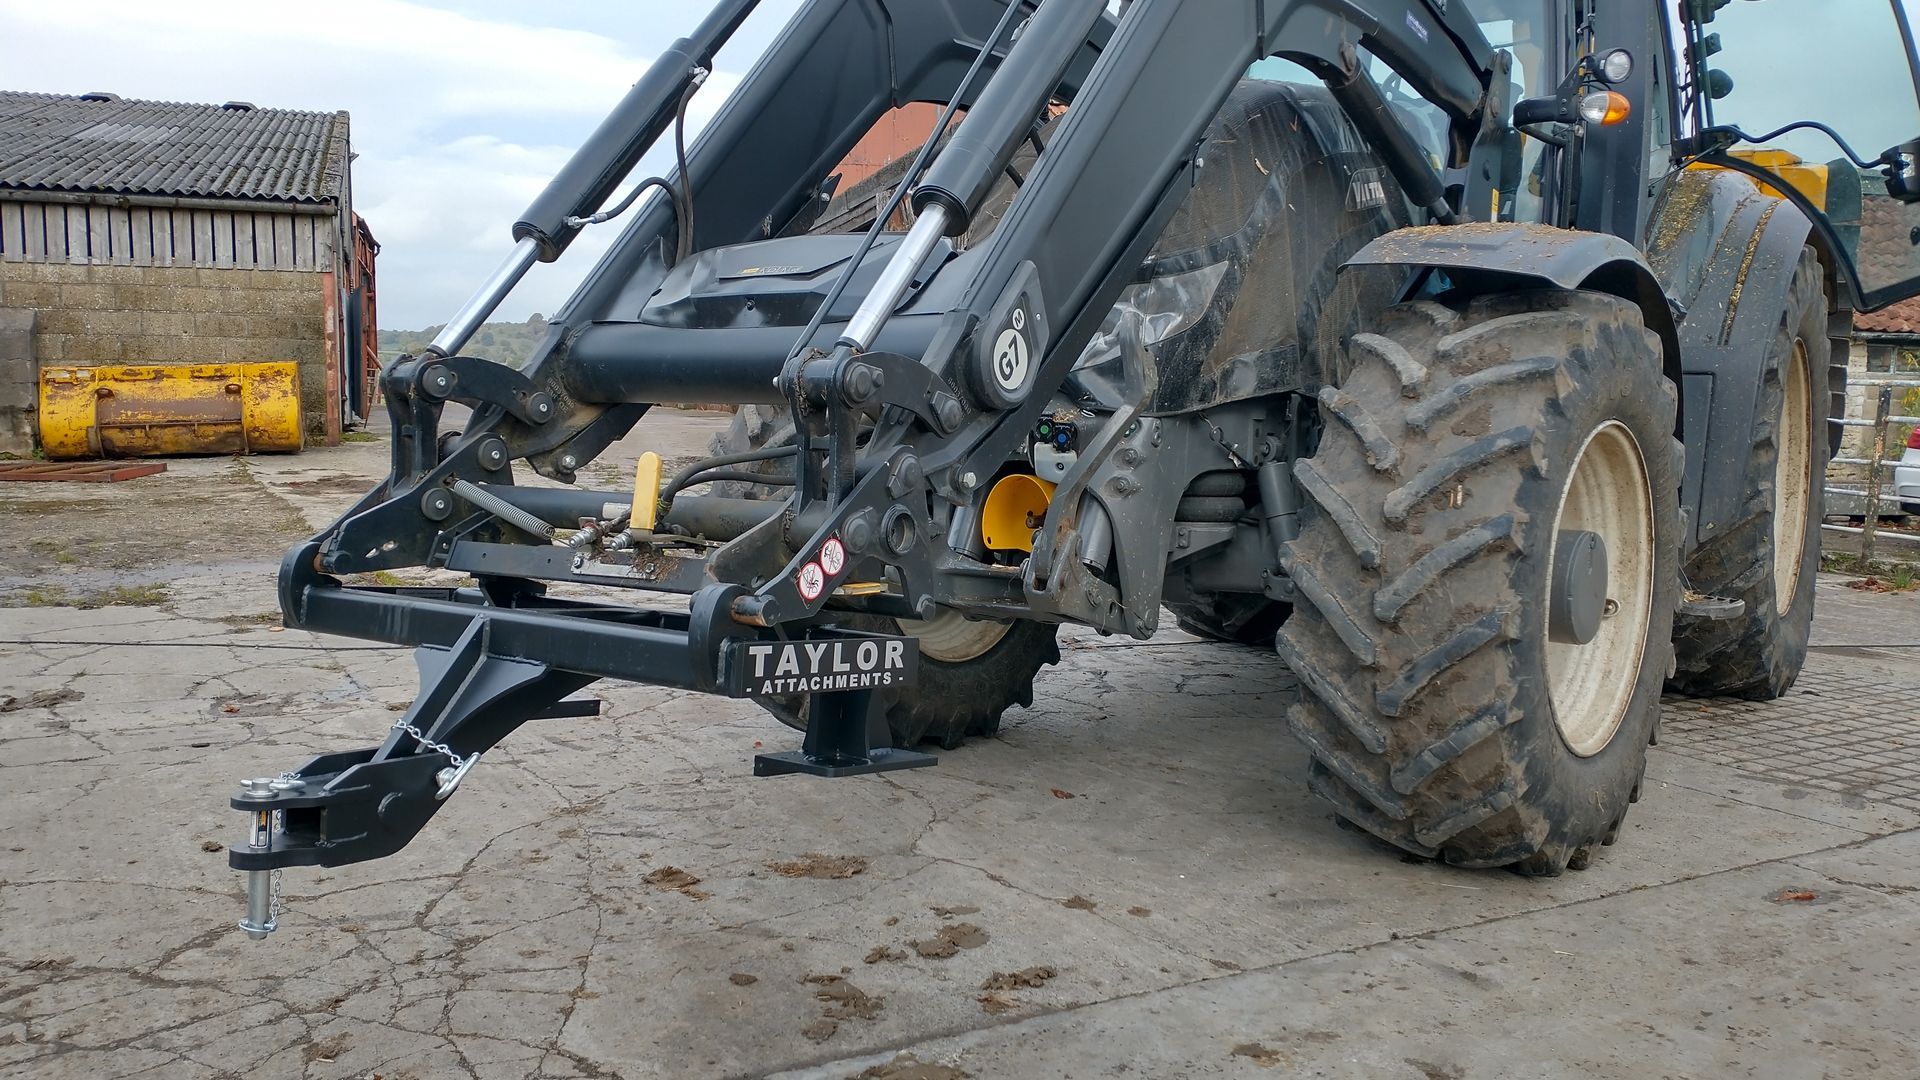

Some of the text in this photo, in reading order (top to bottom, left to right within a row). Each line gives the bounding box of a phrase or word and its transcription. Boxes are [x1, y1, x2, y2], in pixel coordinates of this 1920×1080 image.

[998, 334, 1019, 381] G7
[749, 640, 904, 677] TAYLOR
[761, 672, 892, 694] ATTACHMENTS
